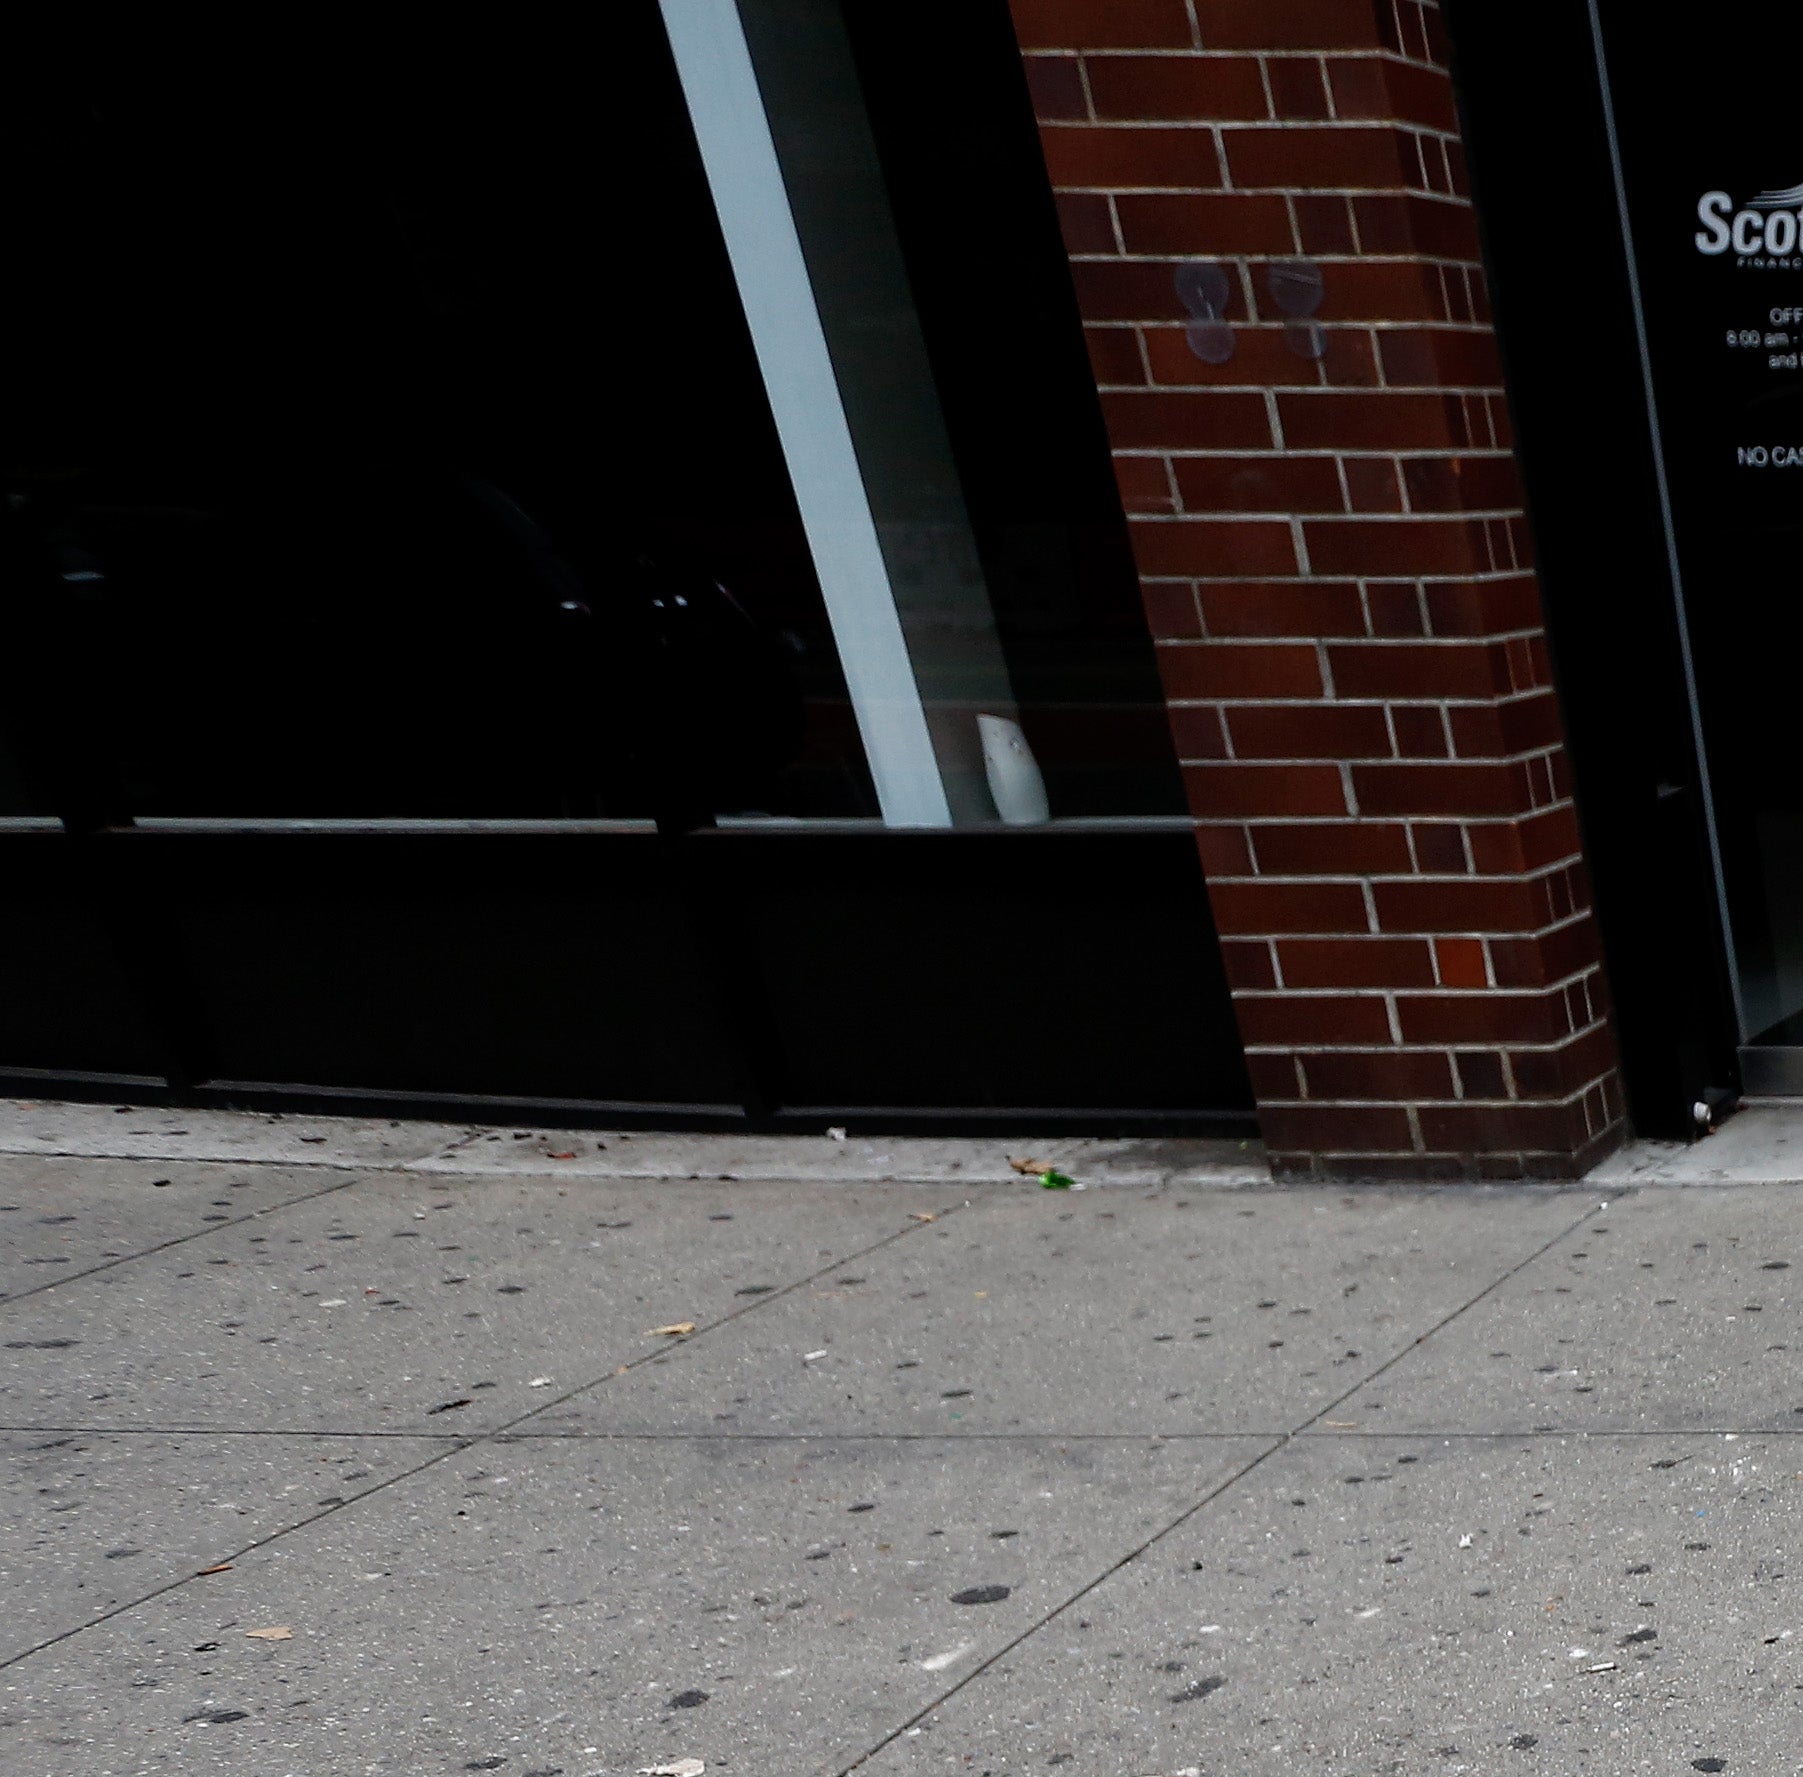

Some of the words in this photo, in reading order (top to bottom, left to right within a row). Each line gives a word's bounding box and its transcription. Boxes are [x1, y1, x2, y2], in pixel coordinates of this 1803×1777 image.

[1764, 332, 1789, 348] am
[1768, 352, 1798, 370] and
[1737, 446, 1769, 468] NO
